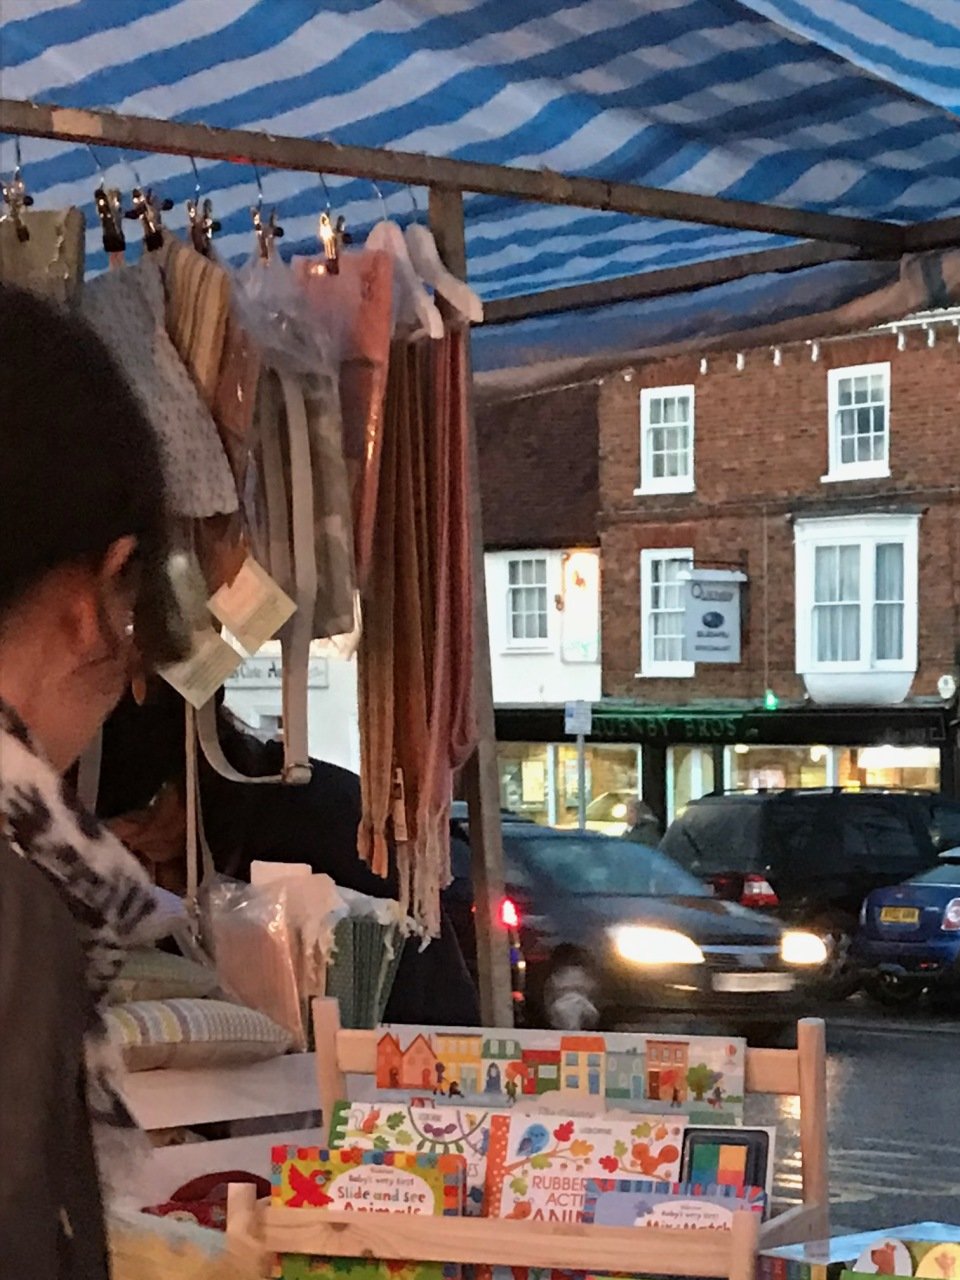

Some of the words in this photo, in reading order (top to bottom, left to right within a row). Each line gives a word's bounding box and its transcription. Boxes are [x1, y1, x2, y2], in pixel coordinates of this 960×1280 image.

[337, 1186, 370, 1200] Slide
[373, 1188, 400, 1202] and
[403, 1191, 427, 1203] see
[545, 1193, 588, 1206] ACTI
